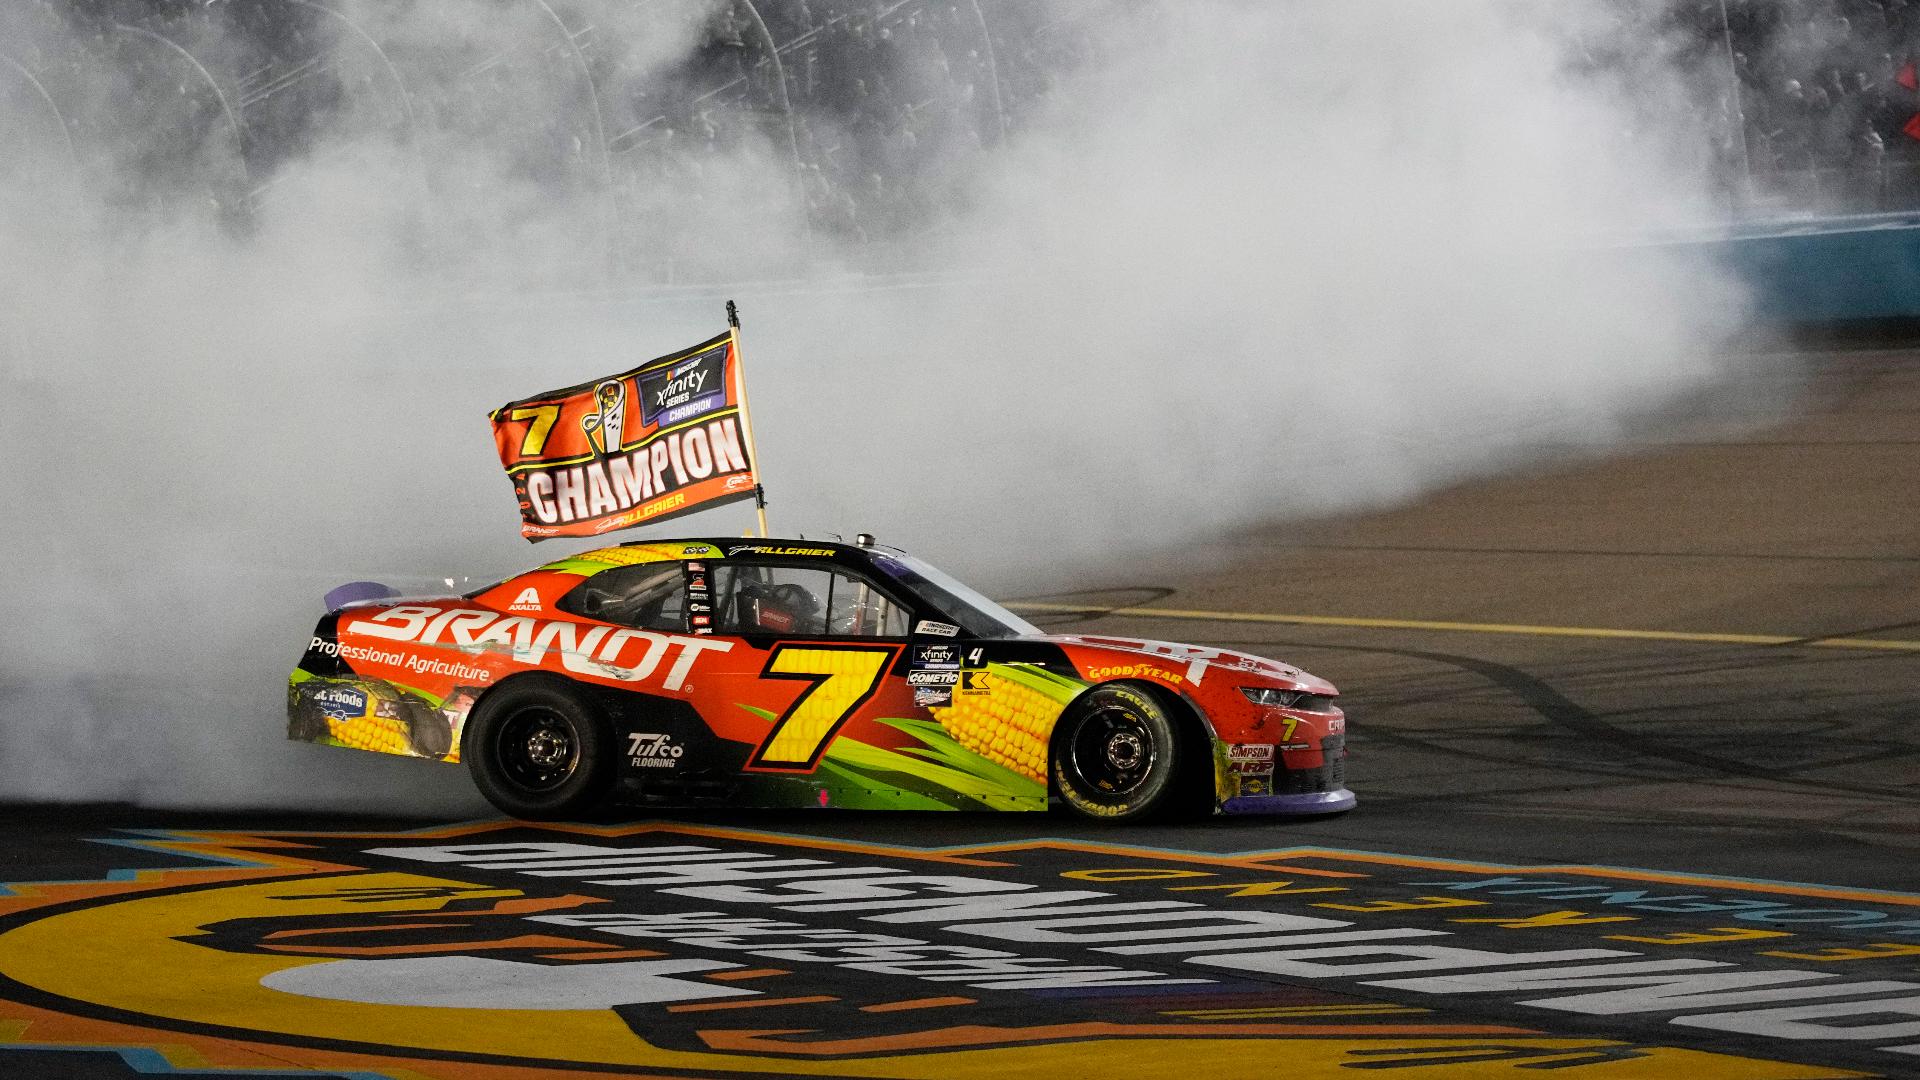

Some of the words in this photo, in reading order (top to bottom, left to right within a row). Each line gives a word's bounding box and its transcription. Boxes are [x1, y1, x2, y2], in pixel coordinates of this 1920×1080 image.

[657, 369, 709, 406] xfinity
[665, 392, 690, 408] SERIES
[669, 398, 712, 422] CHAMPION
[511, 404, 560, 457] 7
[527, 417, 747, 524] CHAMPION
[755, 547, 837, 557] ALLGAIER
[308, 637, 405, 667] Professional
[405, 654, 490, 681] Agriculture
[346, 606, 735, 691] BRANDT
[920, 650, 954, 660] xfinity
[968, 647, 984, 665] 4
[909, 672, 959, 683] COMETIC
[1089, 663, 1183, 684] GOODYEAR
[750, 643, 900, 769] 7
[1280, 716, 1299, 742] 7
[627, 732, 685, 757] Tufco
[1229, 746, 1270, 758] SIMPSON
[631, 757, 676, 768] FLOORING
[1060, 868, 1920, 972] EEKEND
